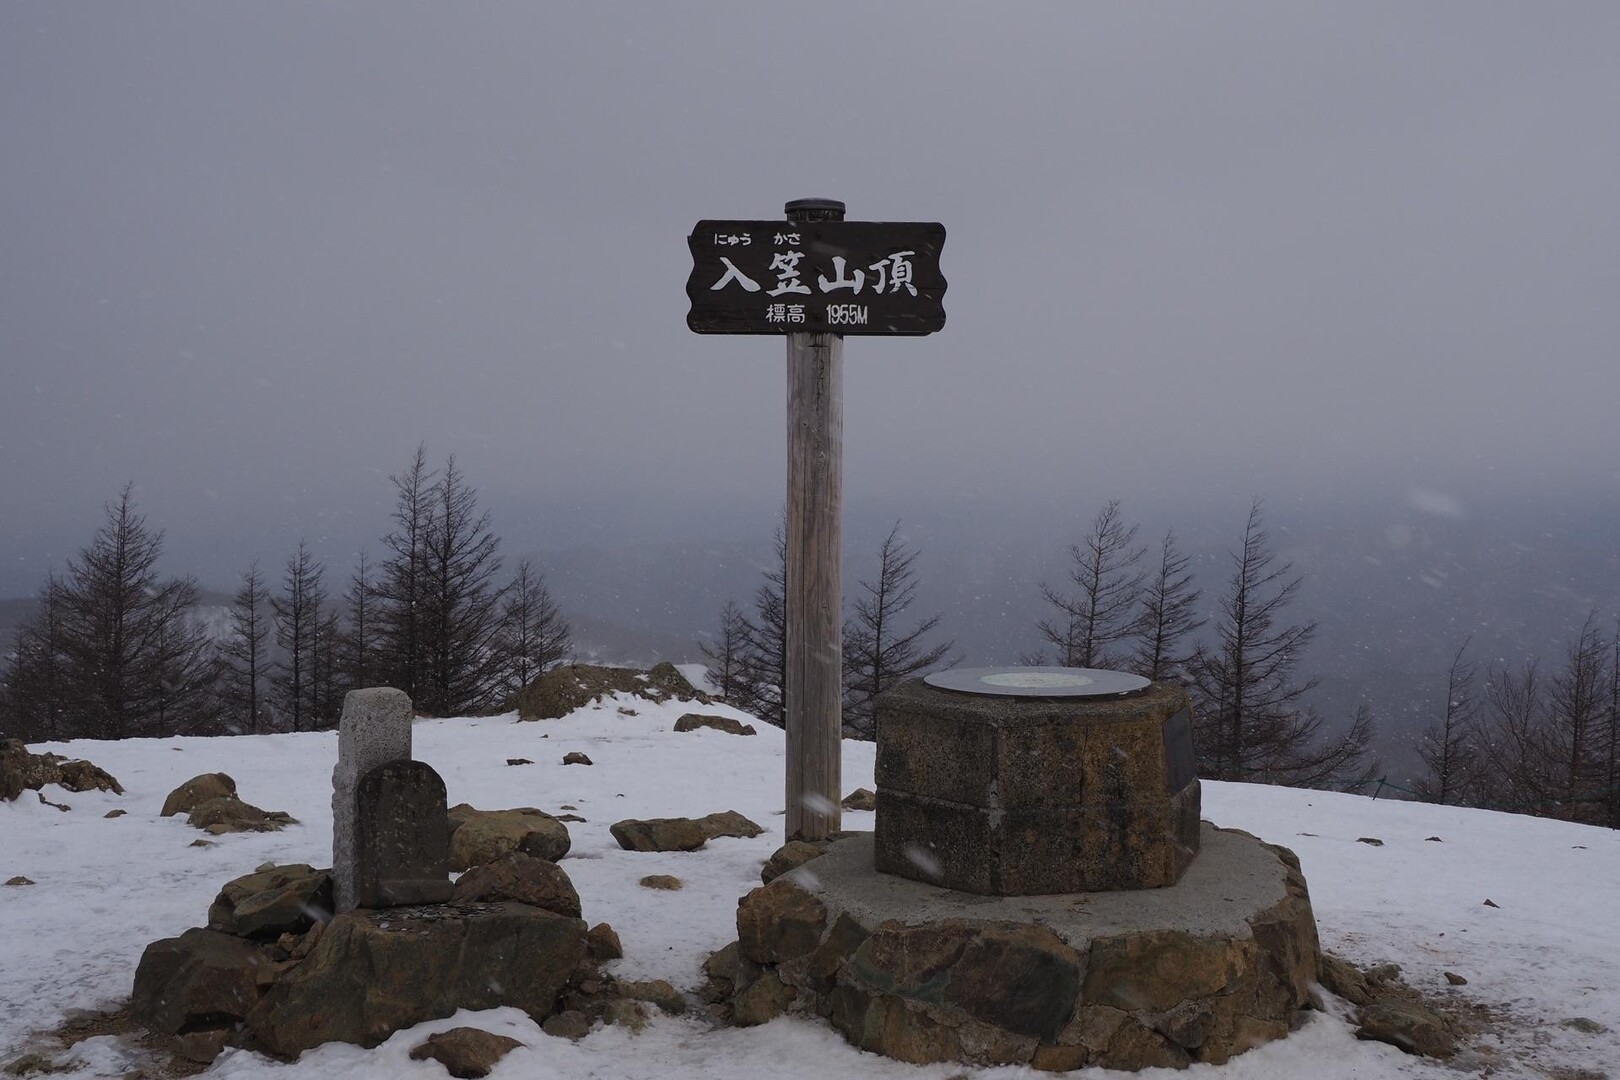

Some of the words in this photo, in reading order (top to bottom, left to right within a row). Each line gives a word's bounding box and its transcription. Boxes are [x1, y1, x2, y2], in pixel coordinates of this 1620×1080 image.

[714, 233, 752, 246] にゅう
[773, 232, 801, 245] かさ
[710, 250, 918, 298] 入笠山頂
[766, 303, 805, 324] 標高
[826, 304, 868, 325] 1955M
